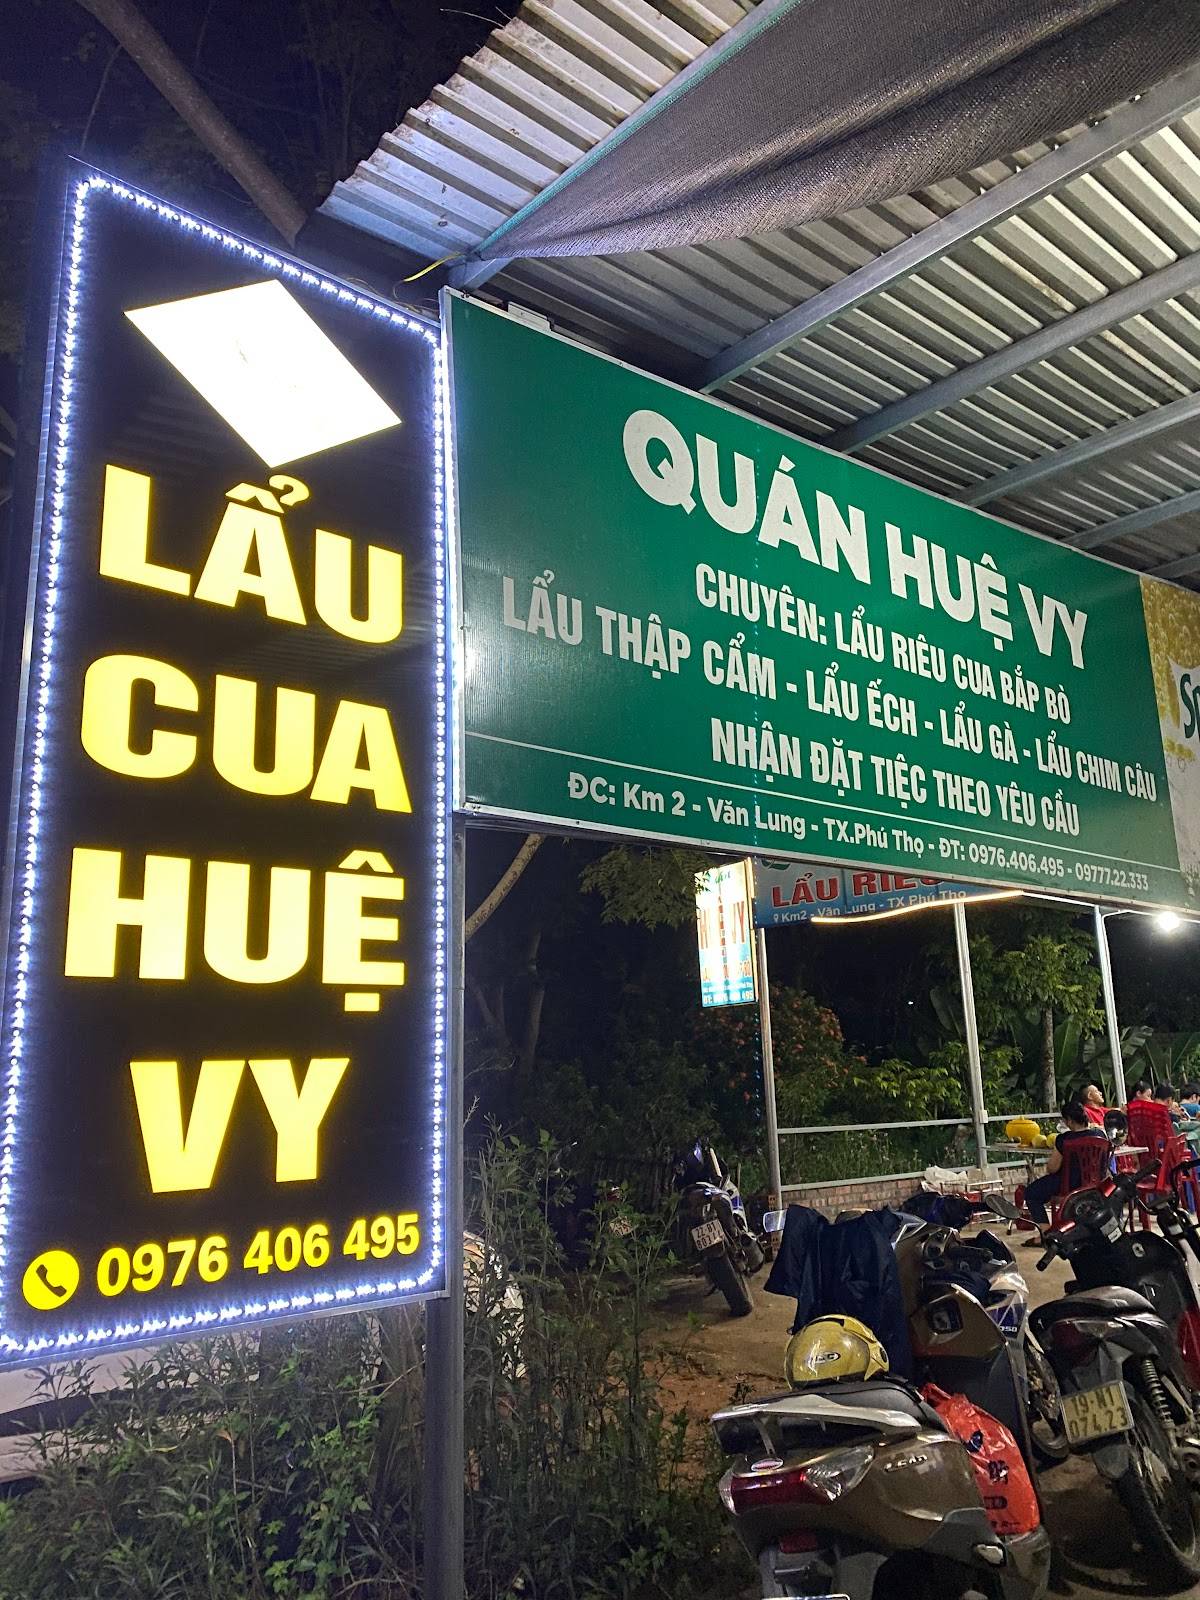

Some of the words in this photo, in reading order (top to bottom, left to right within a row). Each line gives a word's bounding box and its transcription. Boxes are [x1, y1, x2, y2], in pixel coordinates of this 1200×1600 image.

[99, 464, 403, 644] LẨU
[622, 409, 872, 585] QUÁN
[884, 521, 1014, 652] HUỆ
[1018, 583, 1088, 670] VY
[502, 569, 583, 646] LẨU
[595, 604, 691, 680] THẬP
[702, 631, 777, 700] CẨM
[786, 680, 798, 693] -
[805, 661, 860, 722] LẨU
[866, 678, 918, 738] ẾCH
[924, 719, 934, 730] -
[939, 701, 983, 755] LẨU
[988, 720, 1019, 765] GÀ
[1034, 729, 1072, 779] LẨU
[1076, 750, 1122, 793] CHIM
[1124, 762, 1157, 802] CÂU
[695, 562, 828, 646] CHUYÊN:
[833, 604, 885, 663] LẨU
[890, 633, 947, 684] RIÊU
[952, 653, 997, 701] CUA
[999, 664, 1040, 714] BẮP
[1044, 684, 1072, 725] BÒ
[80, 654, 413, 814] CUA
[711, 717, 800, 783] NHẬN
[809, 737, 863, 797] ĐẶT
[869, 753, 927, 809] TIỆC
[932, 769, 991, 817] THEO
[995, 783, 1036, 827] YÊU
[1040, 788, 1080, 836] CẦU
[567, 771, 616, 806] ĐC:
[623, 781, 665, 813] Km
[671, 790, 686, 817] 2
[707, 796, 749, 827] Văn
[755, 805, 806, 840] Lung
[823, 818, 887, 849] TX.Phú
[891, 828, 924, 859] Thọ
[939, 837, 965, 861] ĐT:
[968, 842, 1065, 878] 0976.406.495
[1075, 862, 1149, 891] 09777.22.333
[772, 872, 839, 908] LẨU
[64, 847, 405, 1012] HUỆ
[782, 910, 807, 922] Km2
[887, 896, 905, 908] TX
[129, 1057, 351, 1193] VY
[96, 1235, 229, 1297] 0976
[244, 1223, 331, 1275] 406
[343, 1213, 421, 1261] 495
